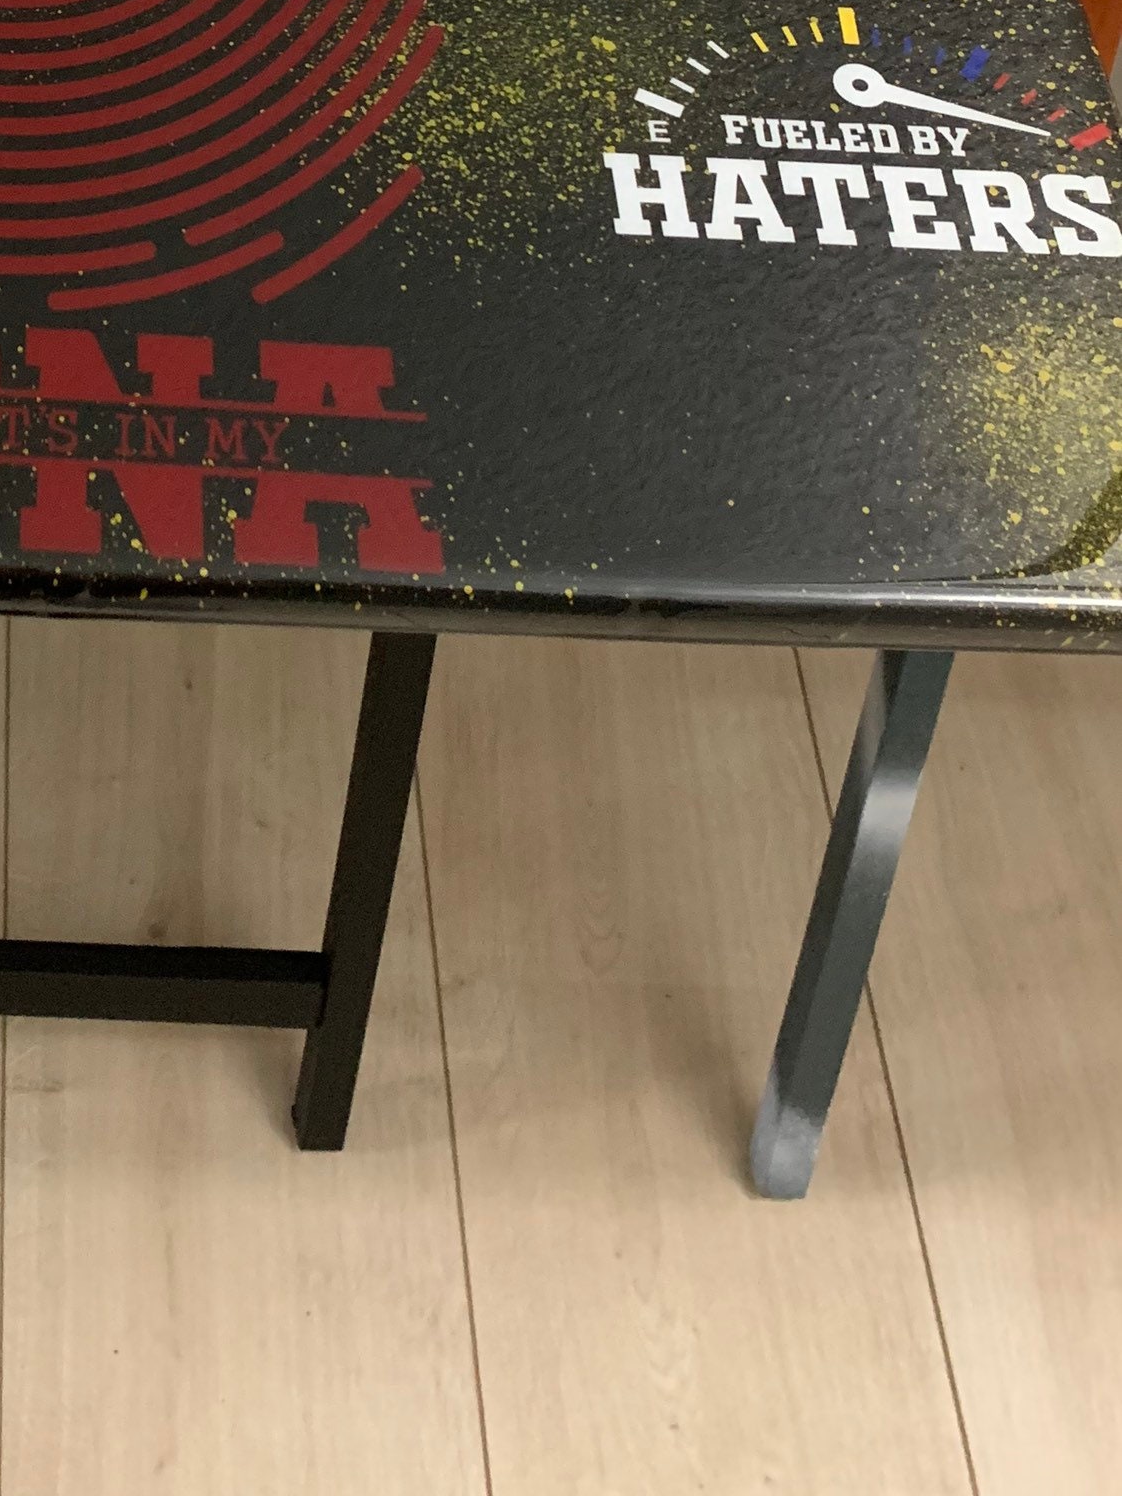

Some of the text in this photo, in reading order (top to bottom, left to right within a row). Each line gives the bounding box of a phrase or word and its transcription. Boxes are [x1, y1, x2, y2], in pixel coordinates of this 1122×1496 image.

[648, 120, 671, 143] E
[720, 113, 971, 158] FUELED BY
[603, 152, 1122, 257] HATERS
[114, 412, 176, 456] IN
[205, 416, 289, 462] MY
